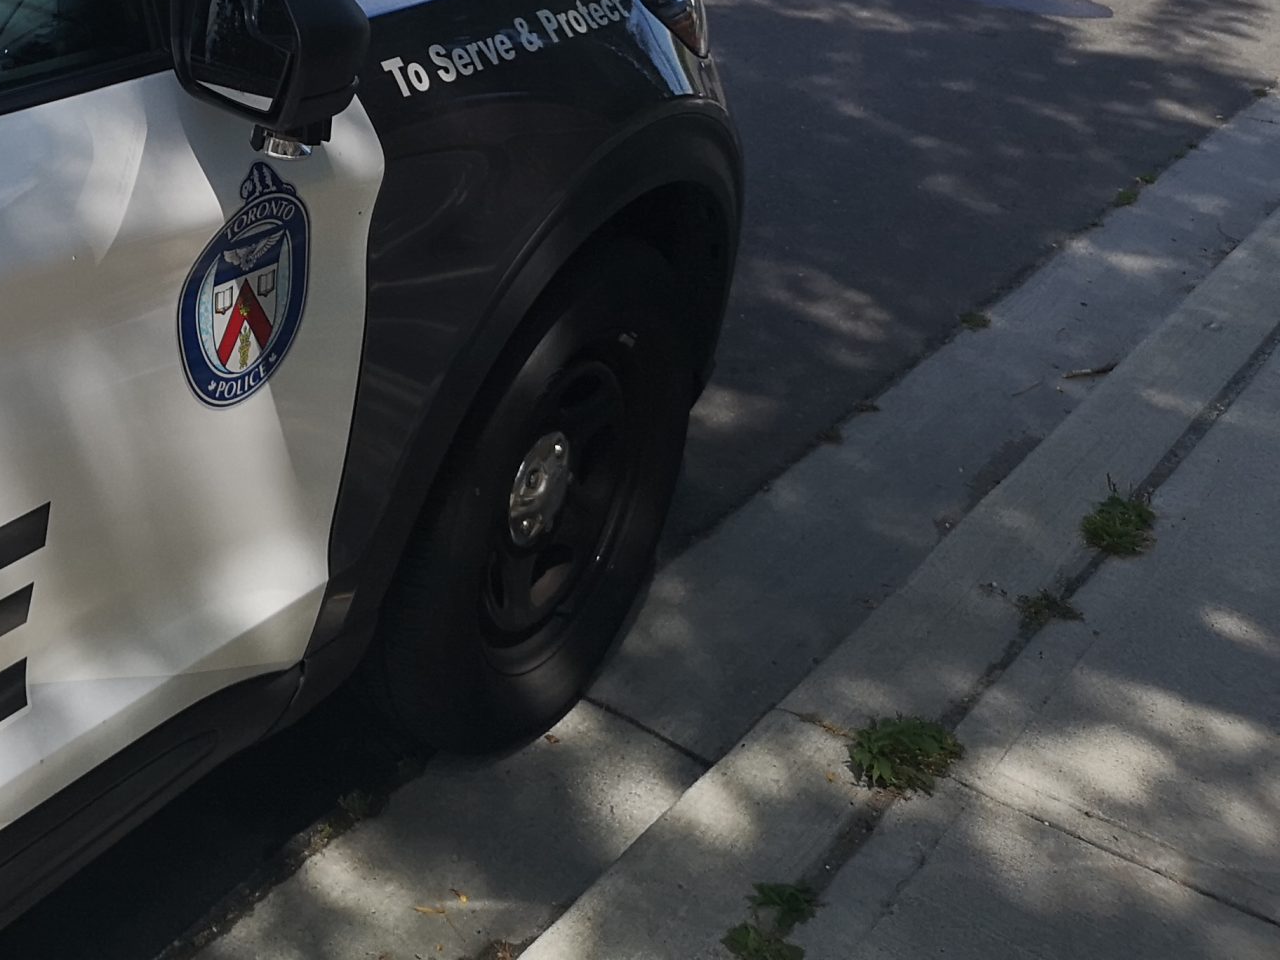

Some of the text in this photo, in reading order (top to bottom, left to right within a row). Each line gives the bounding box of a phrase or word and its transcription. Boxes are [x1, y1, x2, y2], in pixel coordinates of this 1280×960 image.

[380, 56, 430, 98] To
[428, 44, 516, 83] Serve
[514, 17, 543, 52] &
[223, 200, 296, 241] TORONTO
[215, 363, 267, 399] POLICE
